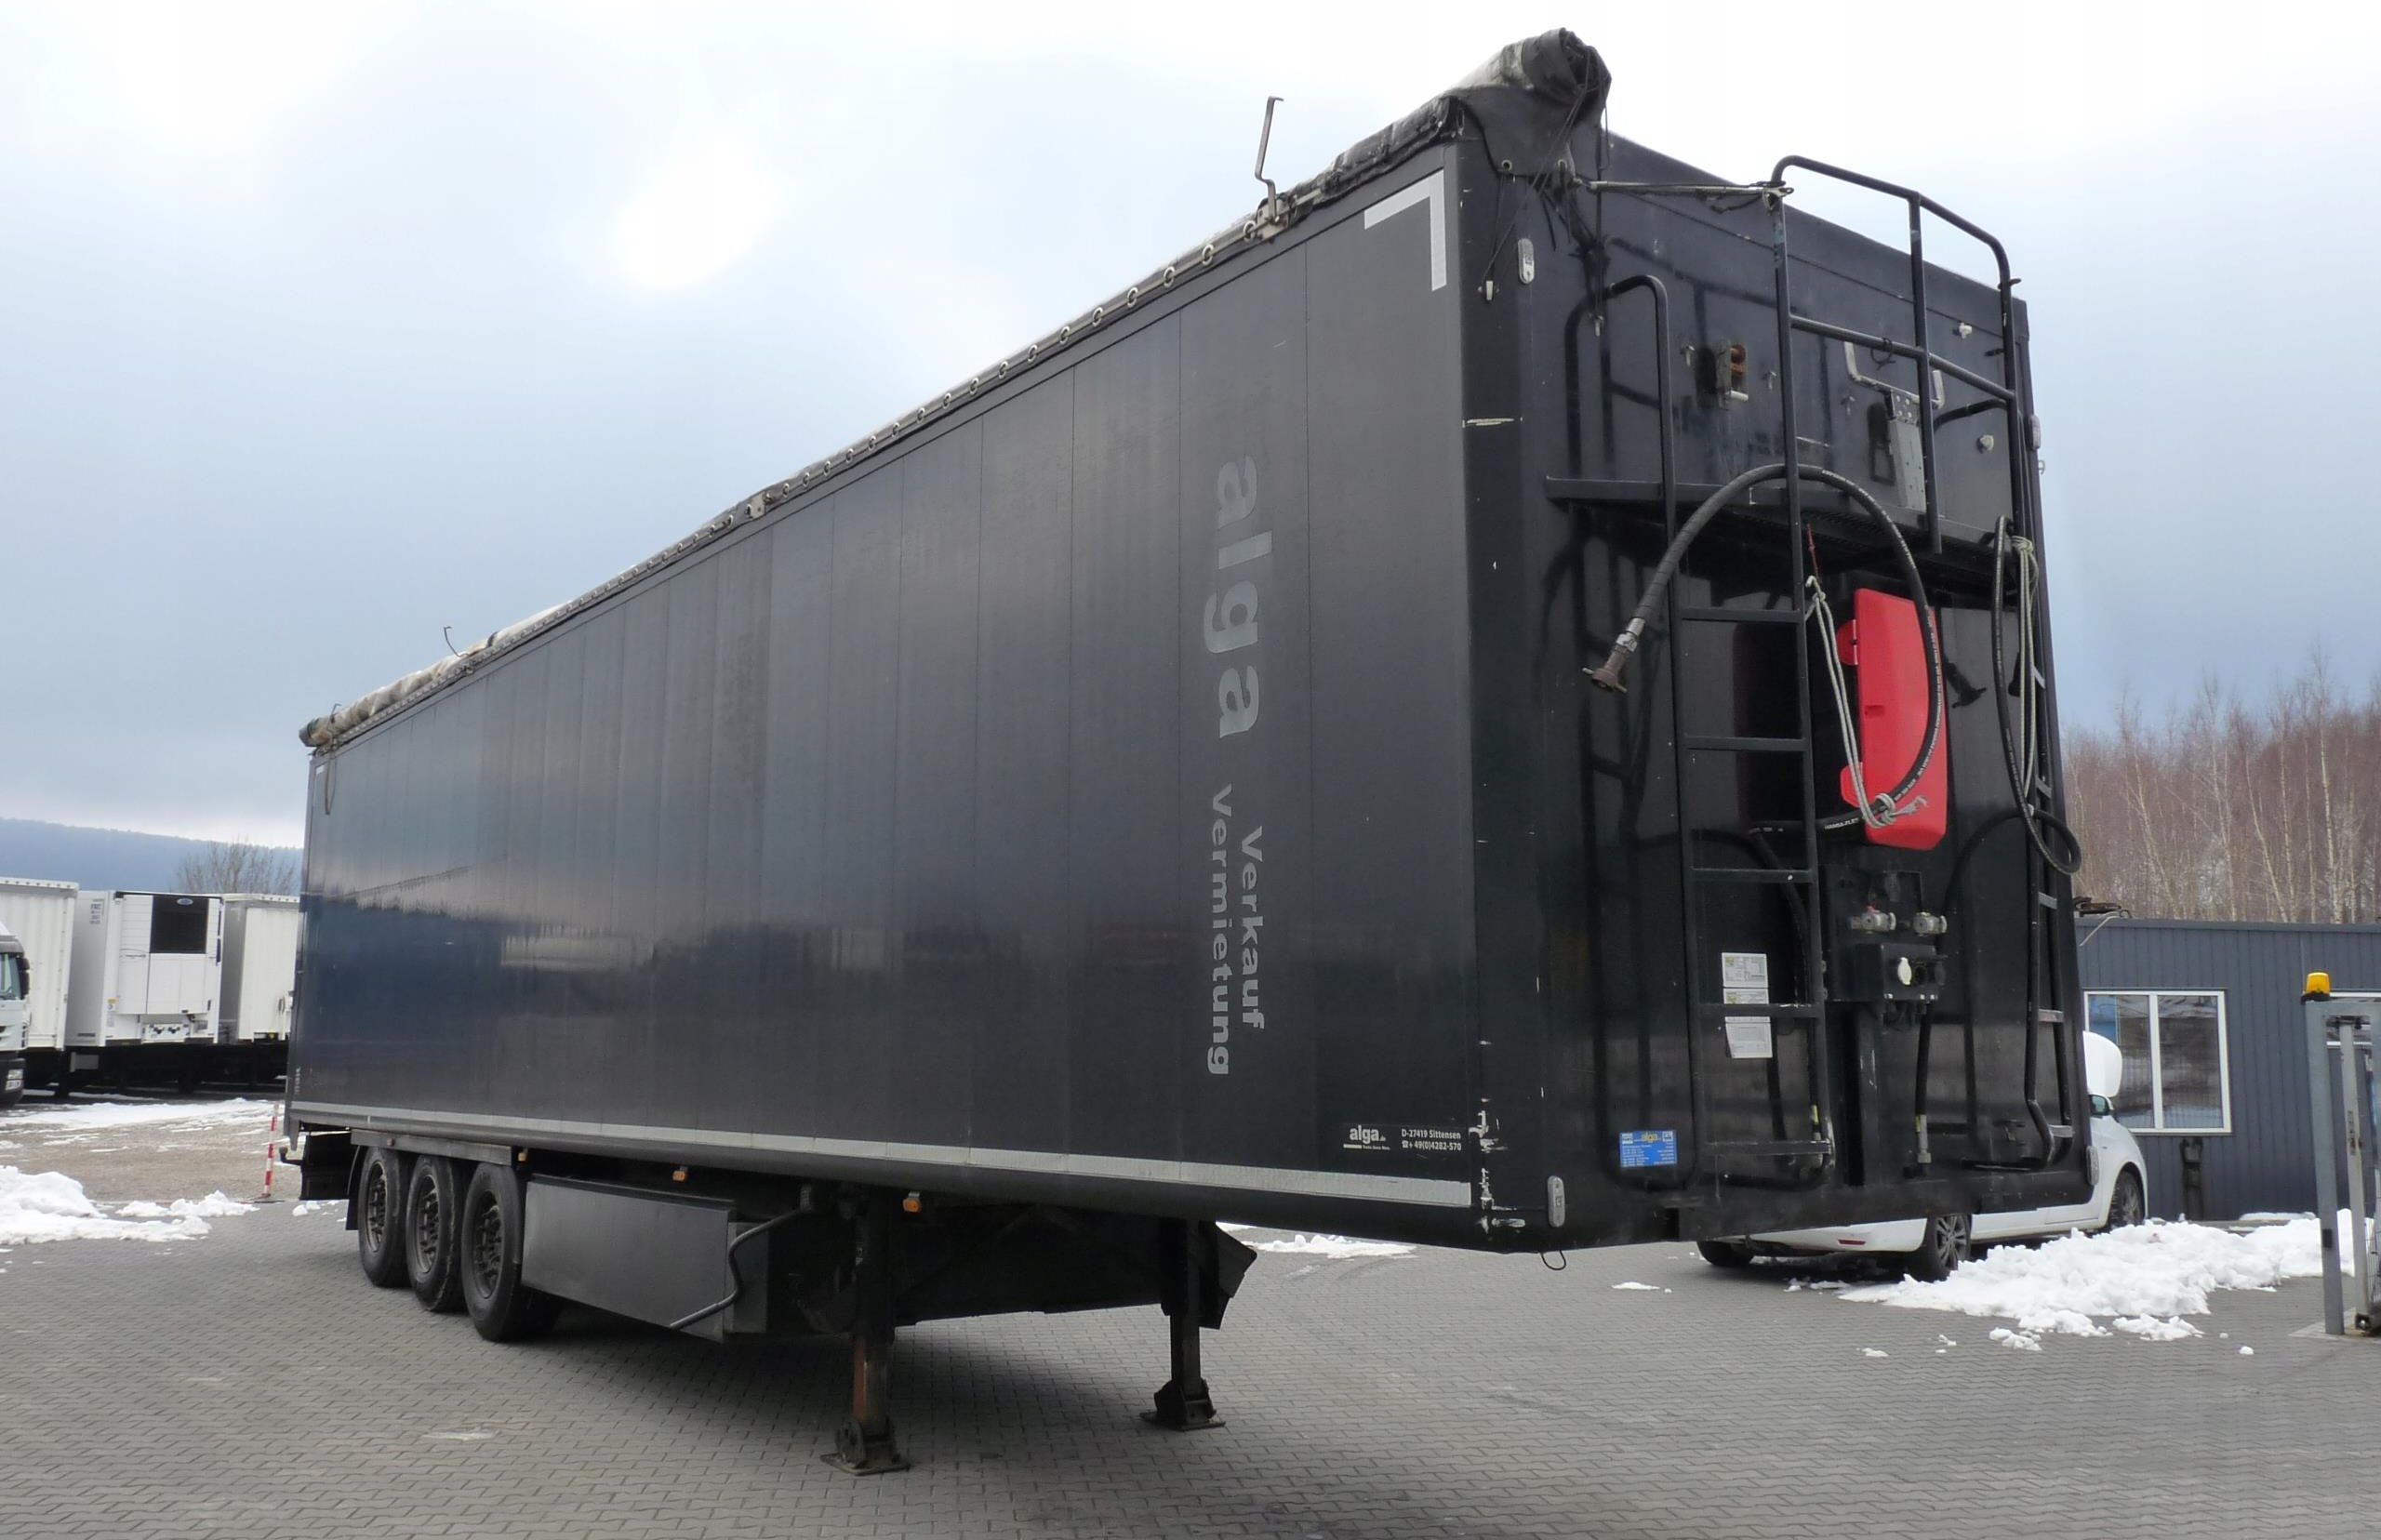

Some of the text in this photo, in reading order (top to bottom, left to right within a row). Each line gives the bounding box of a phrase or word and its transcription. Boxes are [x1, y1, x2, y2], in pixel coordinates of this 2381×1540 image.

[1204, 454, 1272, 739] alga
[1207, 784, 1233, 1075] Vermietung
[1242, 825, 1265, 1029] Verkauf
[1401, 1128, 1461, 1139] D-27419 Sittensen
